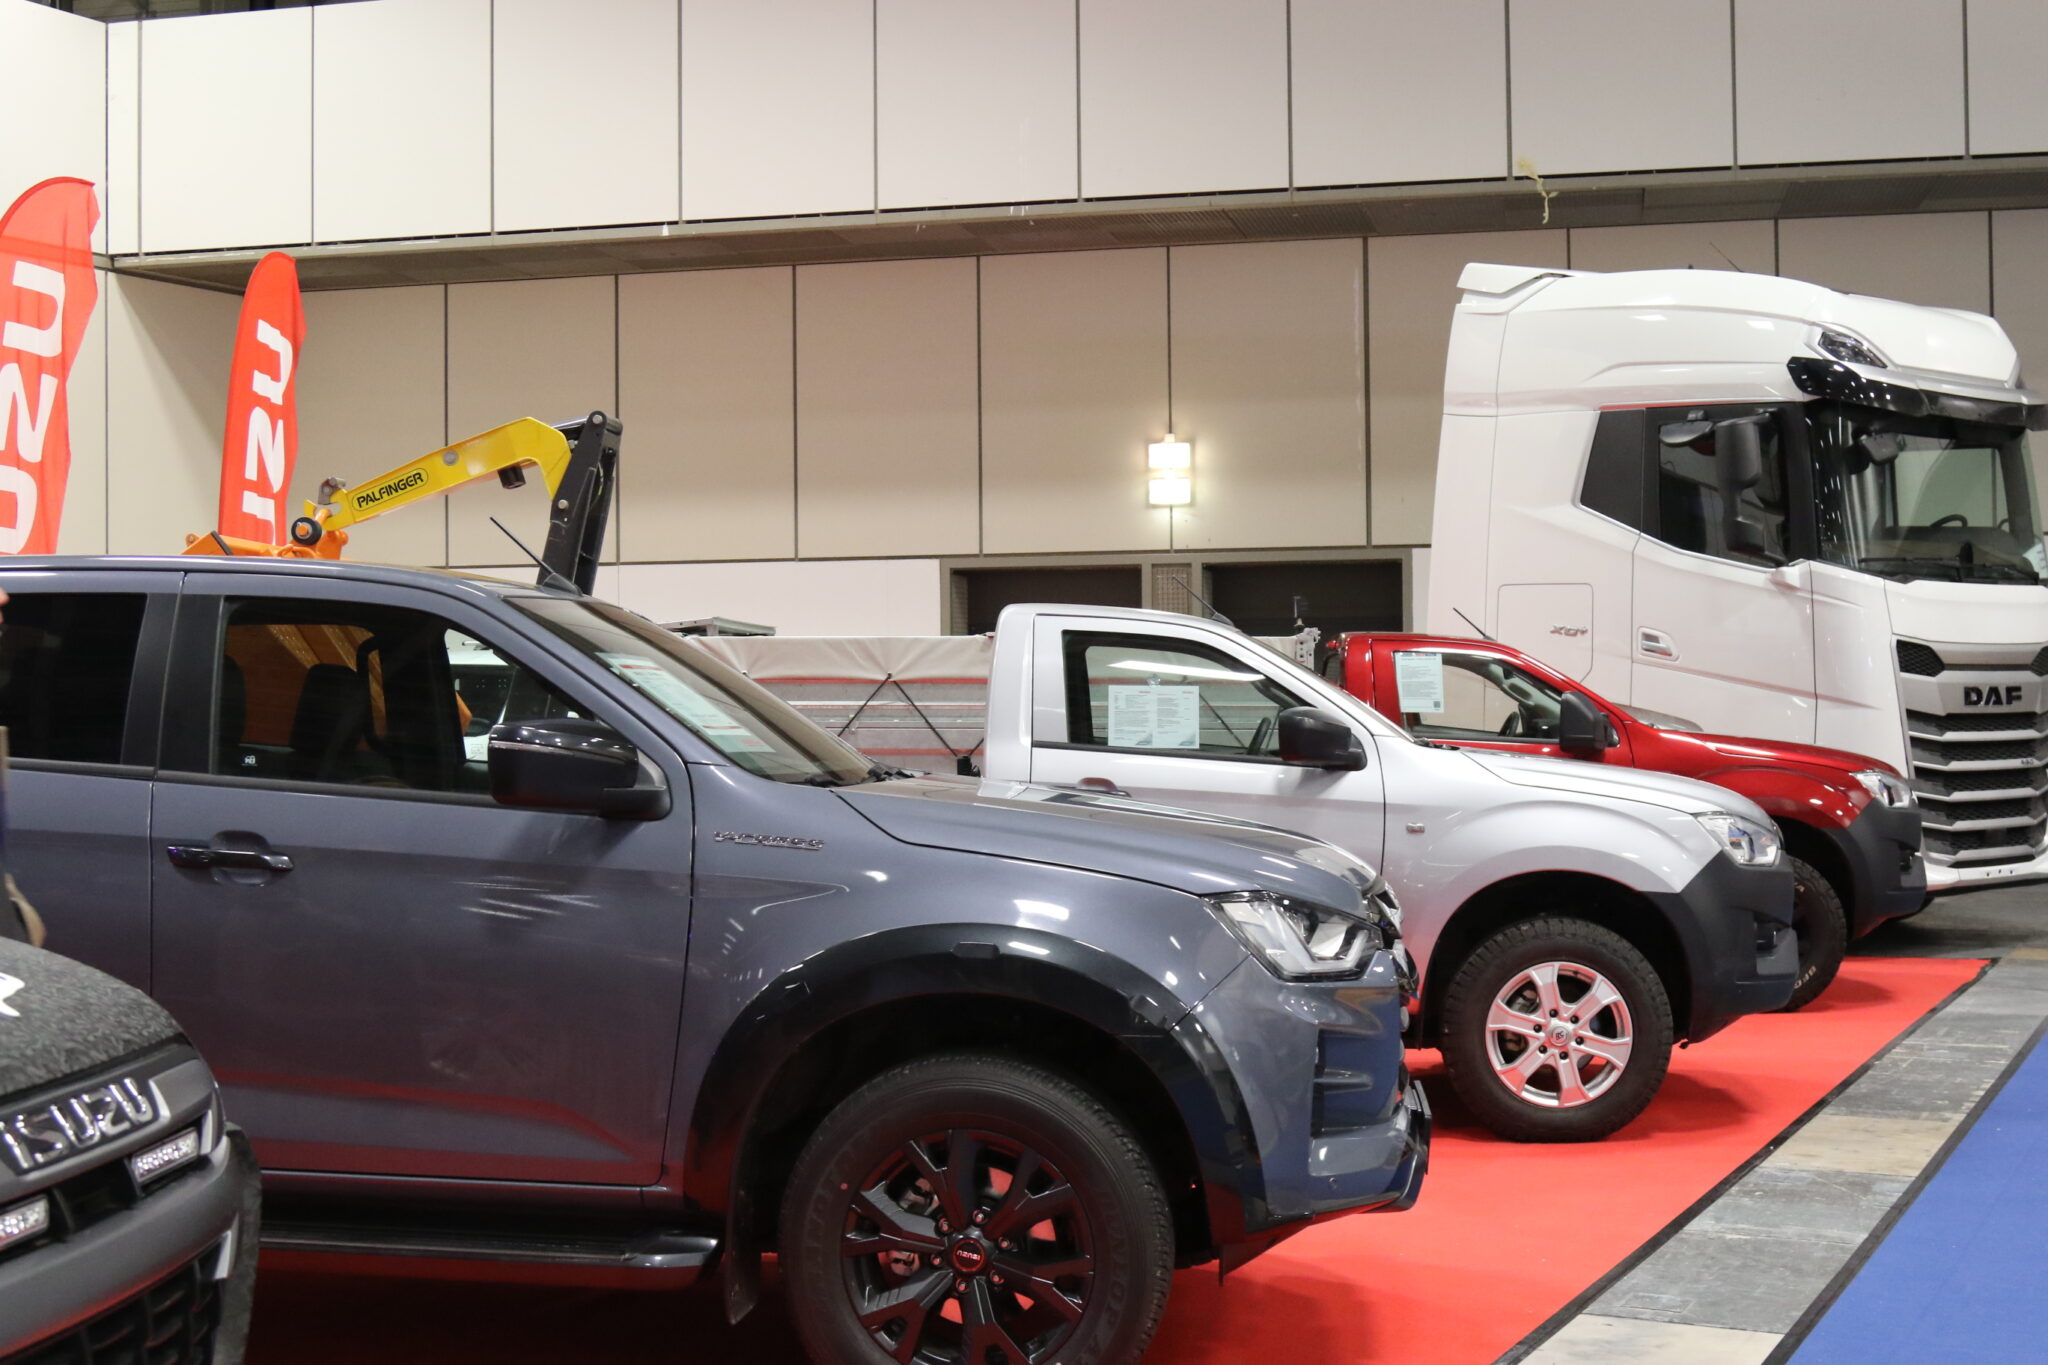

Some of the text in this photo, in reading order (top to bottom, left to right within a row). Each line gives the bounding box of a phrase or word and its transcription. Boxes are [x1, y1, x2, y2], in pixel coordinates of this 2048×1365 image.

[356, 472, 424, 508] PALFINGER
[1964, 686, 2022, 706] DAF
[0, 1078, 153, 1169] ISUZU
